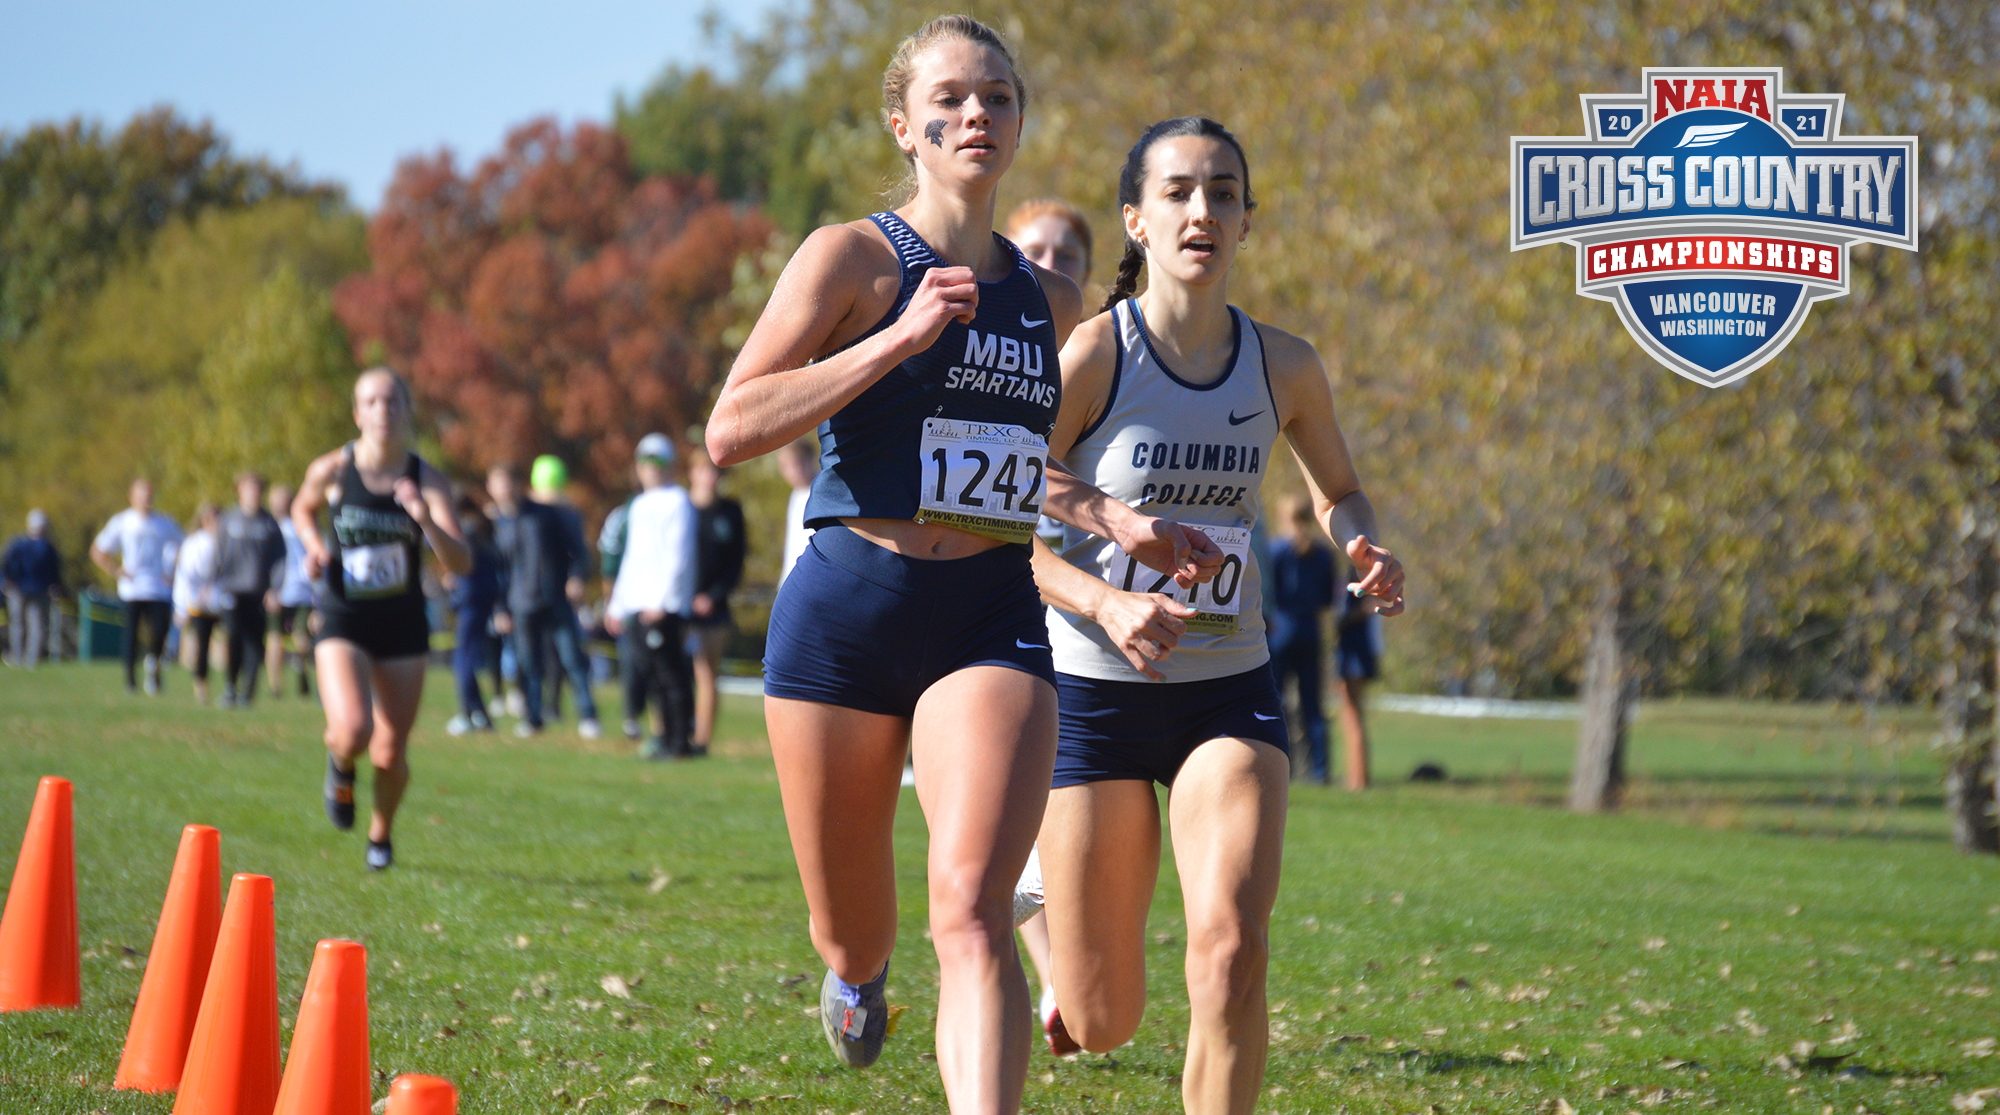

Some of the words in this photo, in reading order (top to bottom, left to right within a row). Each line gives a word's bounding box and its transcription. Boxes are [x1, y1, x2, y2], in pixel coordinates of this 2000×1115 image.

[963, 328, 1044, 378] MBU
[945, 366, 1056, 409] SPARTANS
[962, 422, 1021, 439] TRXC
[1131, 441, 1260, 474] COLUMBIA
[932, 447, 1044, 514] 1242
[1140, 482, 1248, 507] COLLEGE
